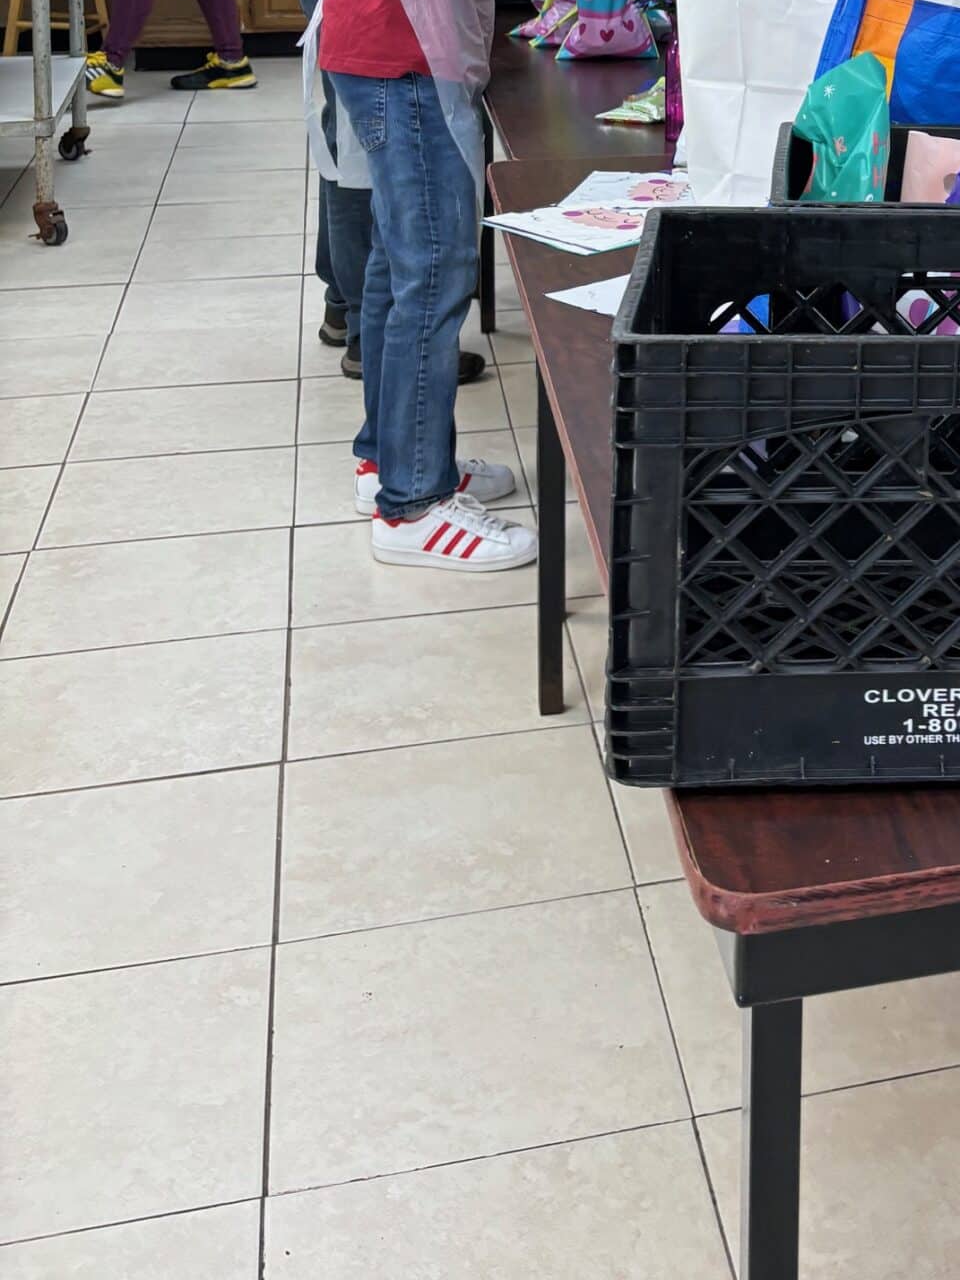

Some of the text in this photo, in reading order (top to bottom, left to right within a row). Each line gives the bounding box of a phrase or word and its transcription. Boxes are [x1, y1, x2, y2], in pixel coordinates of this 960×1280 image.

[864, 735, 886, 745] USE
[888, 734, 903, 744] BY
[905, 733, 943, 744] OTHER
